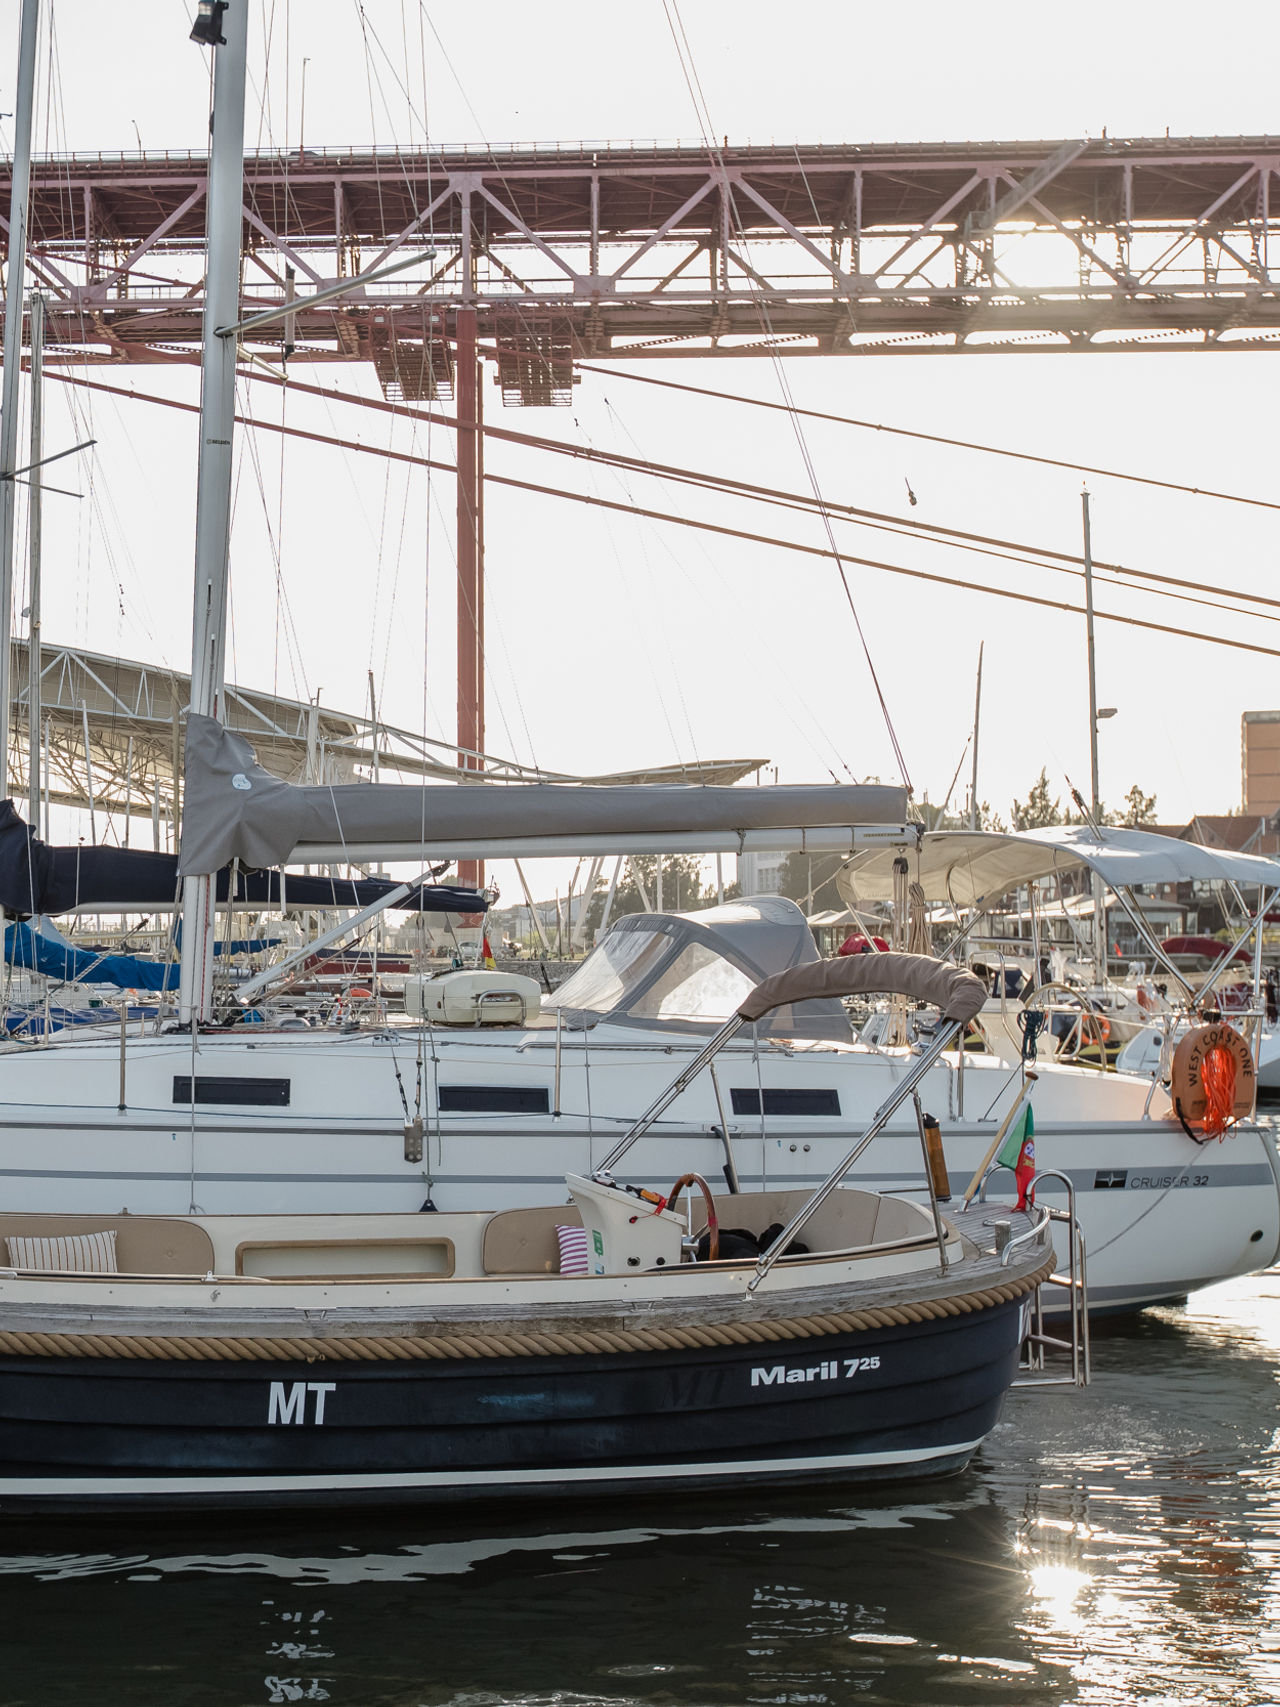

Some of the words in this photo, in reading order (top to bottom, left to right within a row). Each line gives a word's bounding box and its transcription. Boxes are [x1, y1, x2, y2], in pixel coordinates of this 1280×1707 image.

[1188, 1045, 1202, 1088] WEST
[1239, 1046, 1253, 1078] ONE
[1193, 1175, 1209, 1187] 32
[751, 1360, 839, 1387] Maril
[267, 1381, 337, 1425] MT
